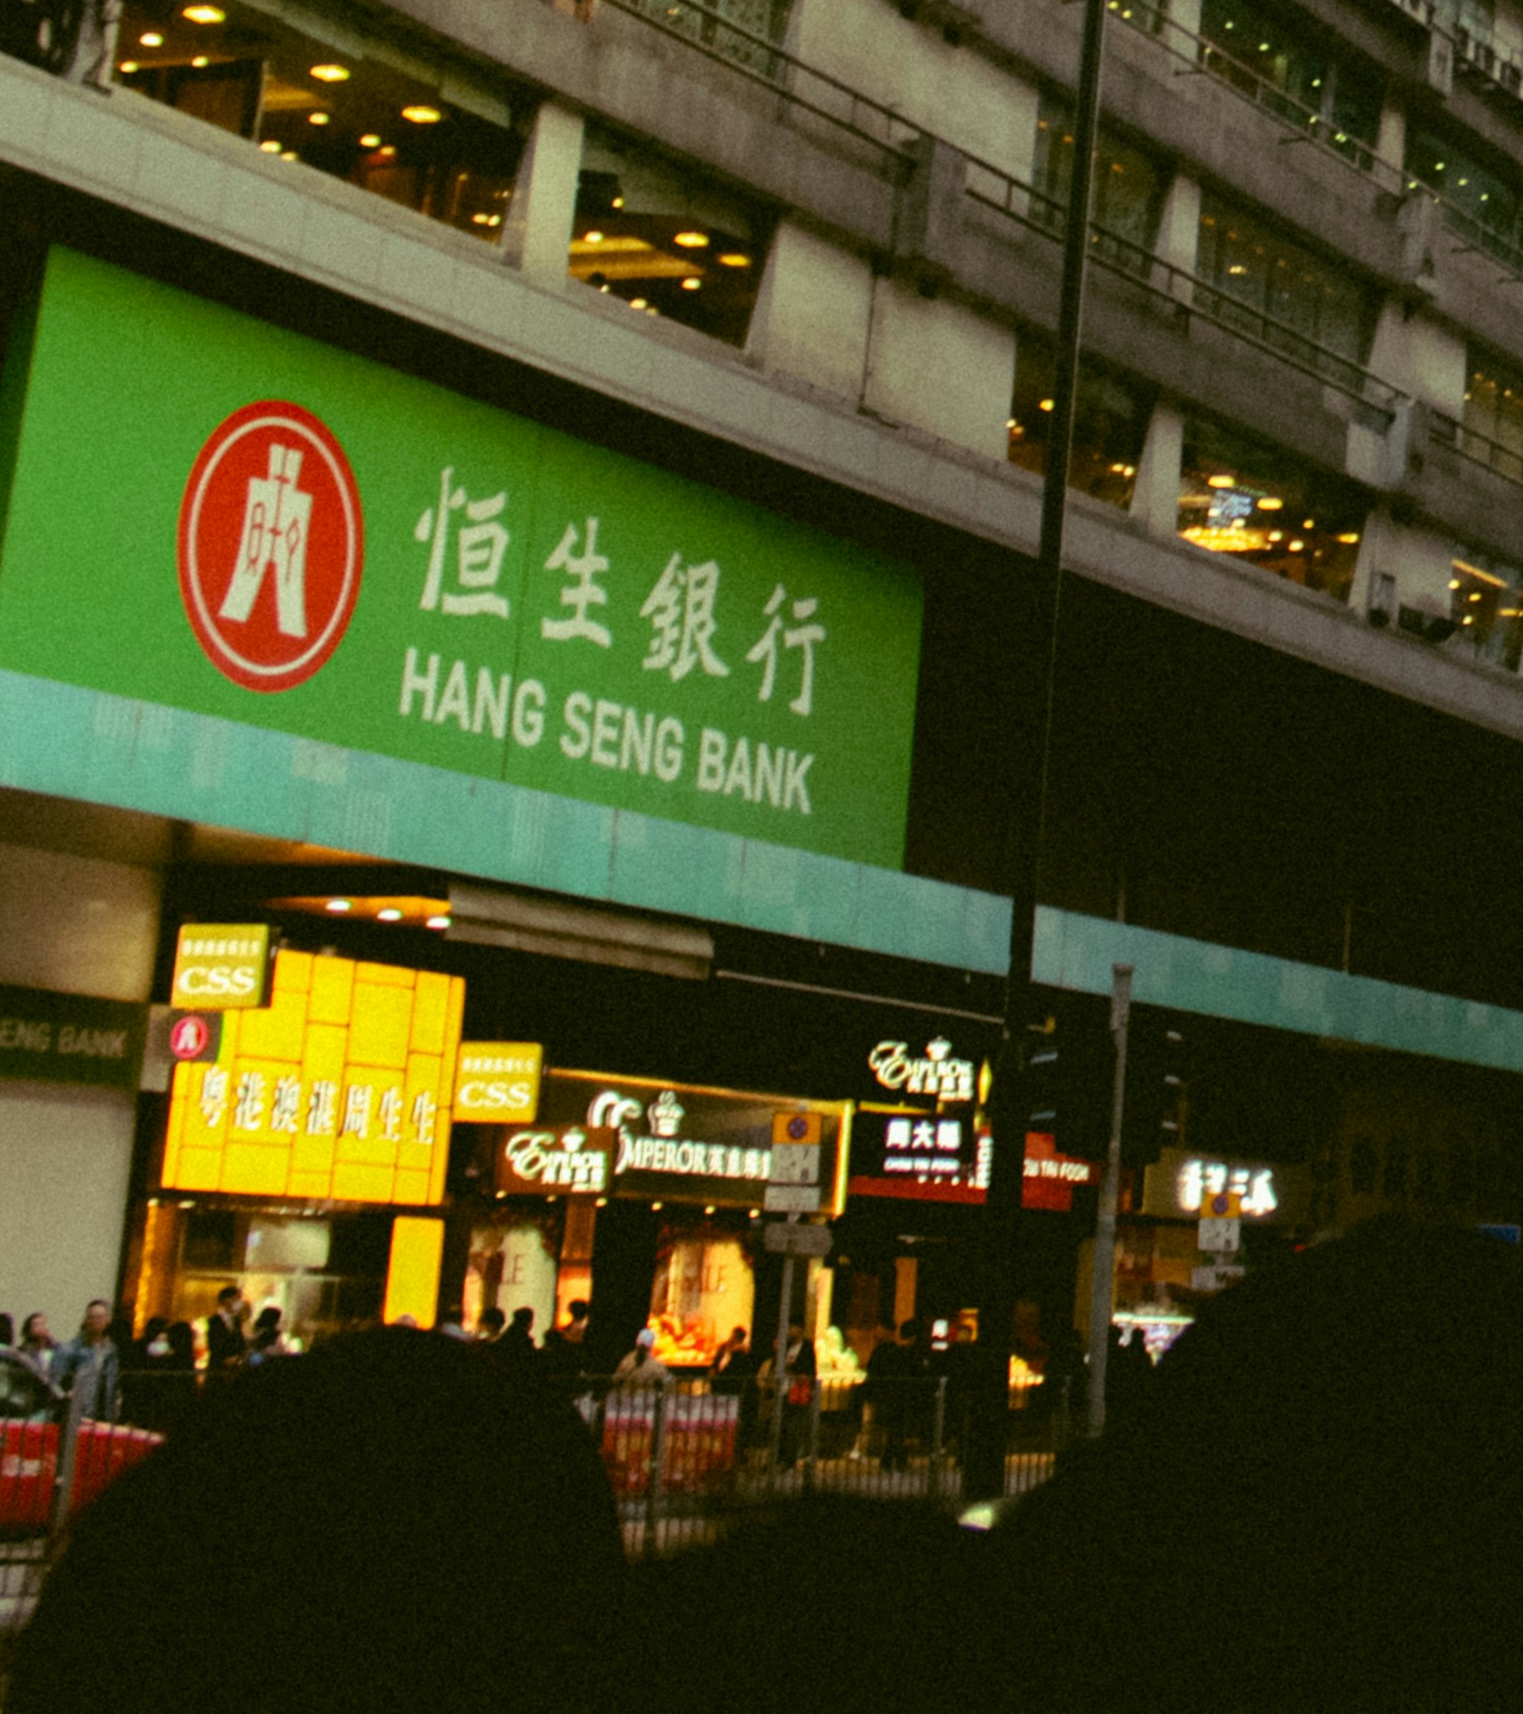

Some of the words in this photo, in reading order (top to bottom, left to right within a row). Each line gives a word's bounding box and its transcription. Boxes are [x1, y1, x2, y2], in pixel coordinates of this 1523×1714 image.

[413, 465, 826, 717] 恒生銀行
[401, 646, 546, 748] HANG
[560, 689, 683, 783] SENG
[697, 726, 815, 815] BANK
[178, 966, 257, 996] CSS
[58, 1026, 126, 1057] BANK
[458, 1081, 532, 1109] CSS
